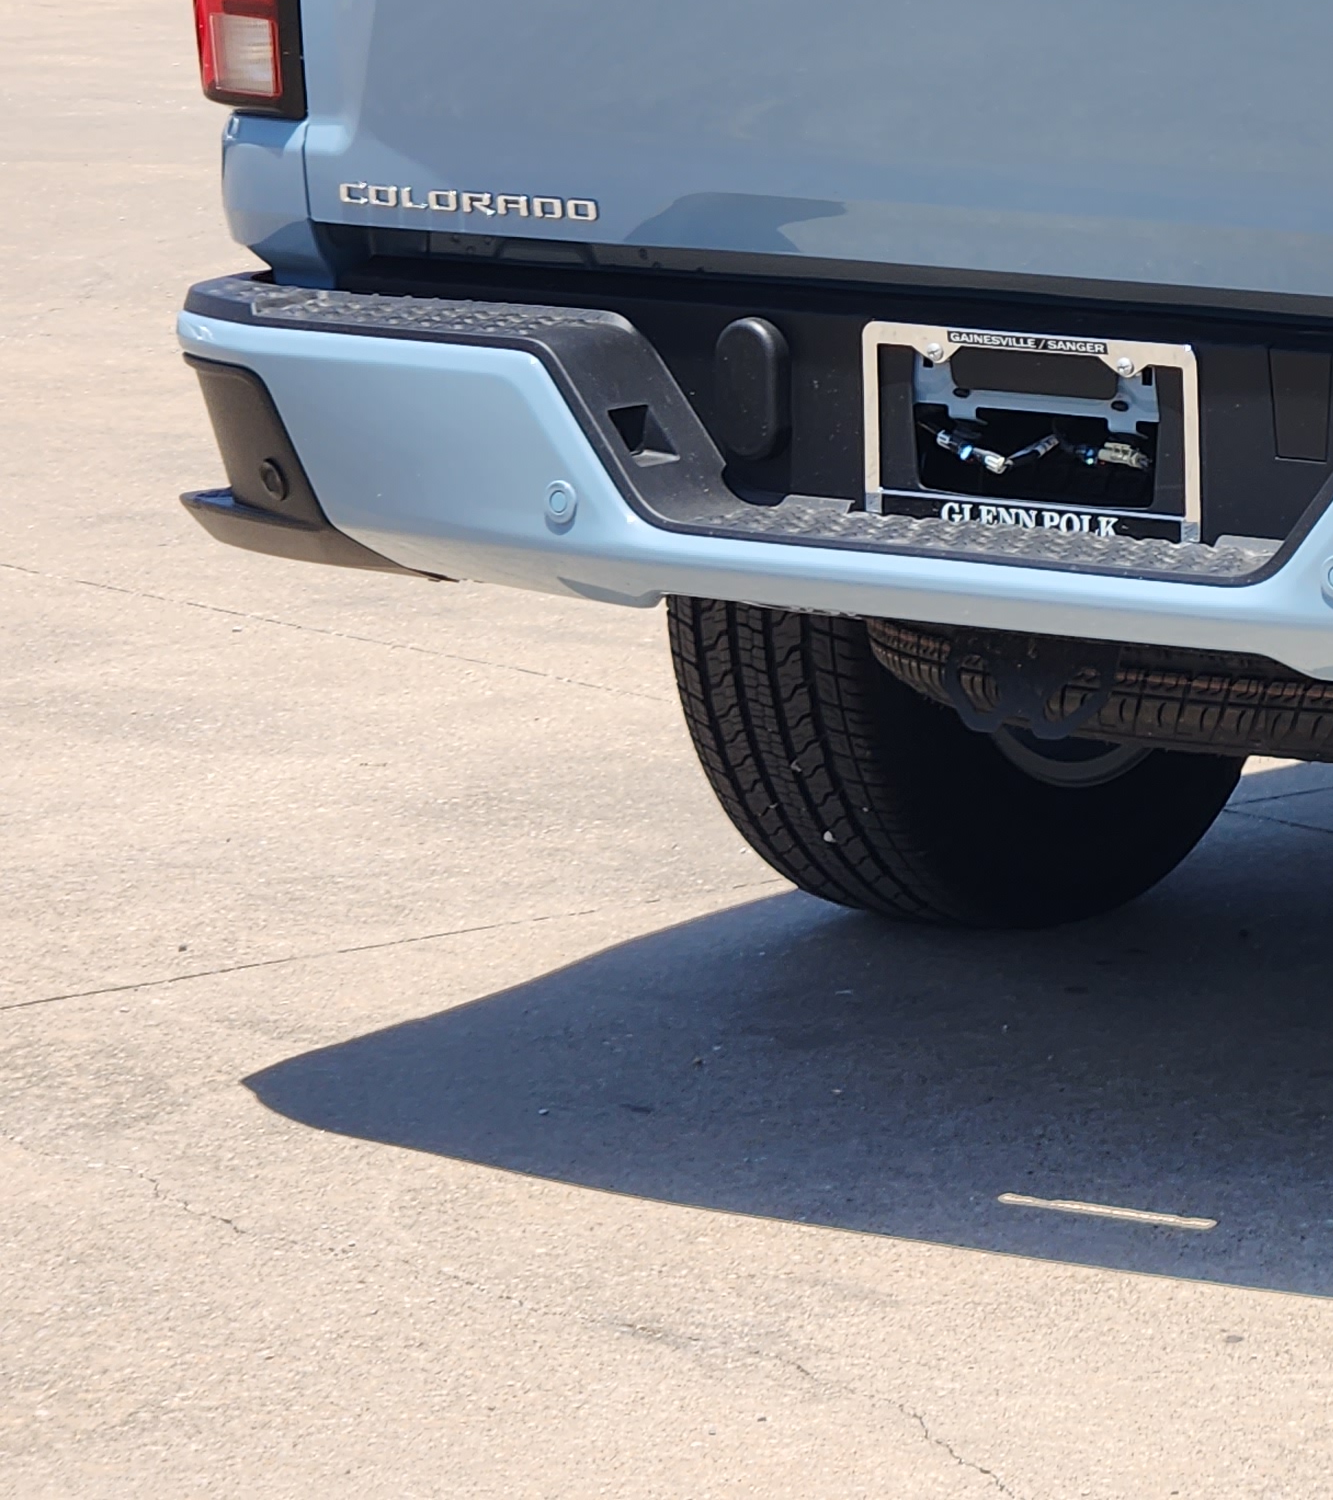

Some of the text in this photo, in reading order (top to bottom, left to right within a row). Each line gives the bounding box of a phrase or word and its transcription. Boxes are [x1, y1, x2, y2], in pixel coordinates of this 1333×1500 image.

[339, 181, 599, 221] COLORADO
[949, 331, 1037, 348] GAINESVILLE
[1047, 340, 1105, 353] SANGER
[941, 501, 1119, 537] GLENN POLK
